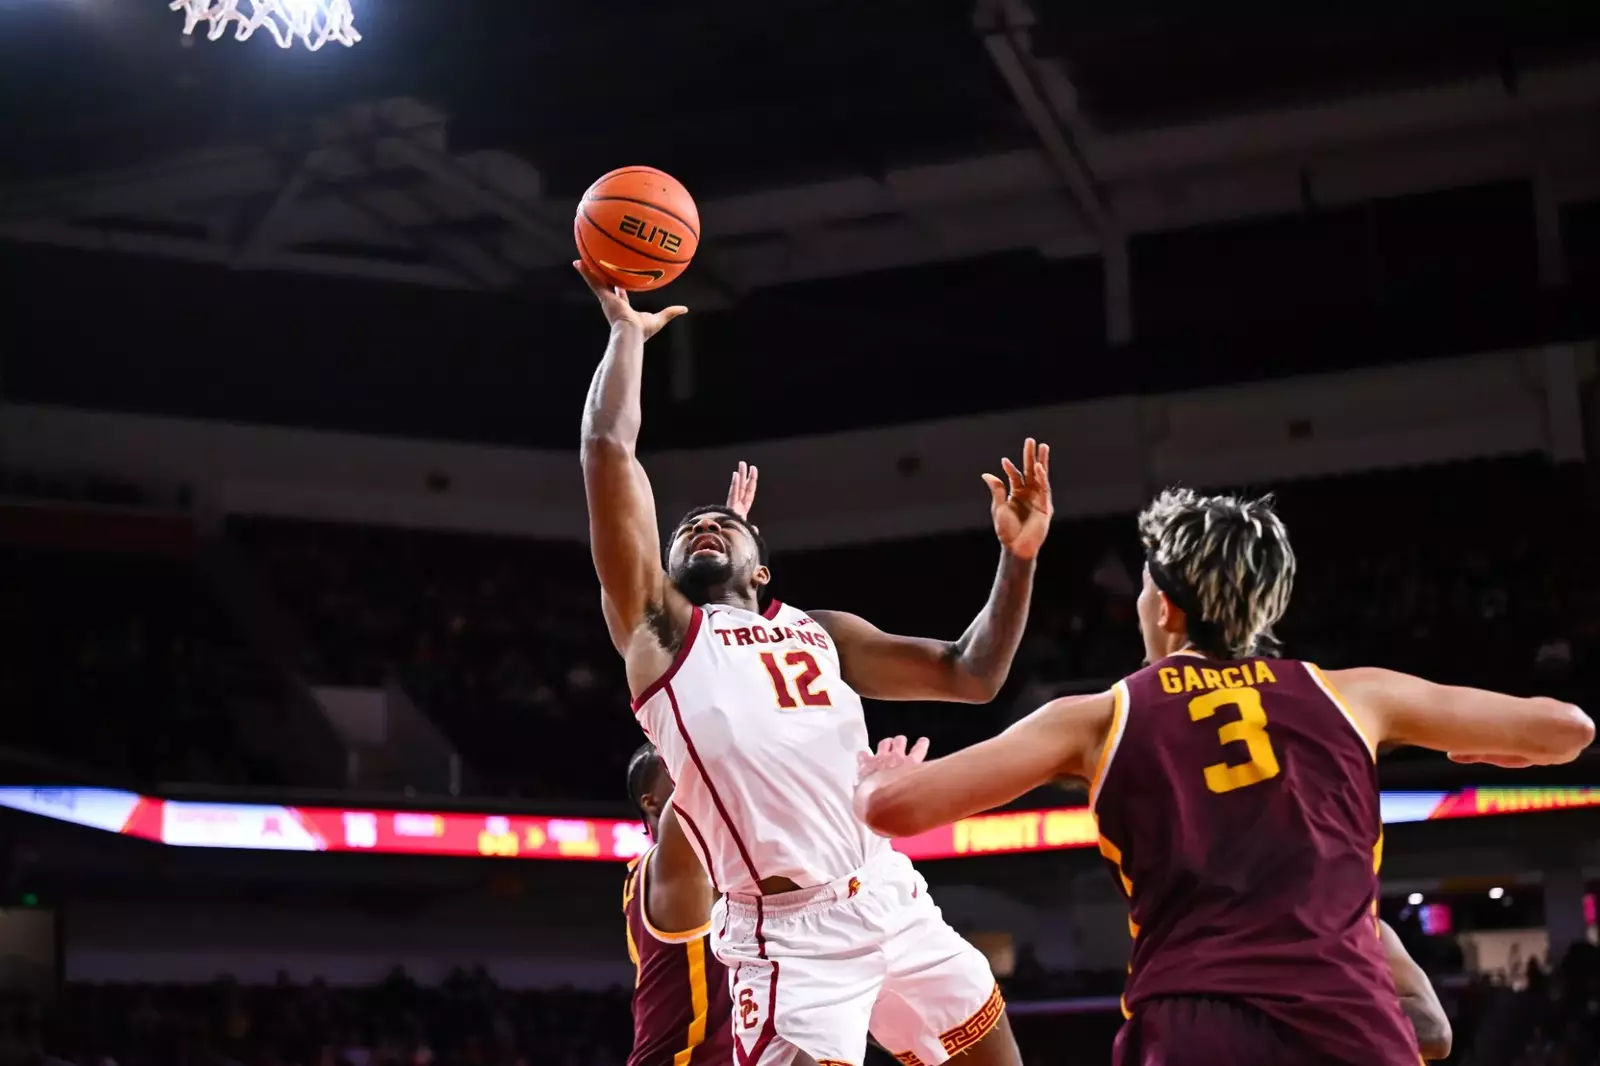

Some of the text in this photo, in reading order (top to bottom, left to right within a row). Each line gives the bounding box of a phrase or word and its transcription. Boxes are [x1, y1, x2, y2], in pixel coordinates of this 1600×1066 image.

[618, 214, 683, 254] ELITE
[714, 625, 829, 650] TROJANS
[759, 650, 833, 709] 12
[1158, 660, 1277, 694] GARCIA
[1188, 687, 1280, 794] 3
